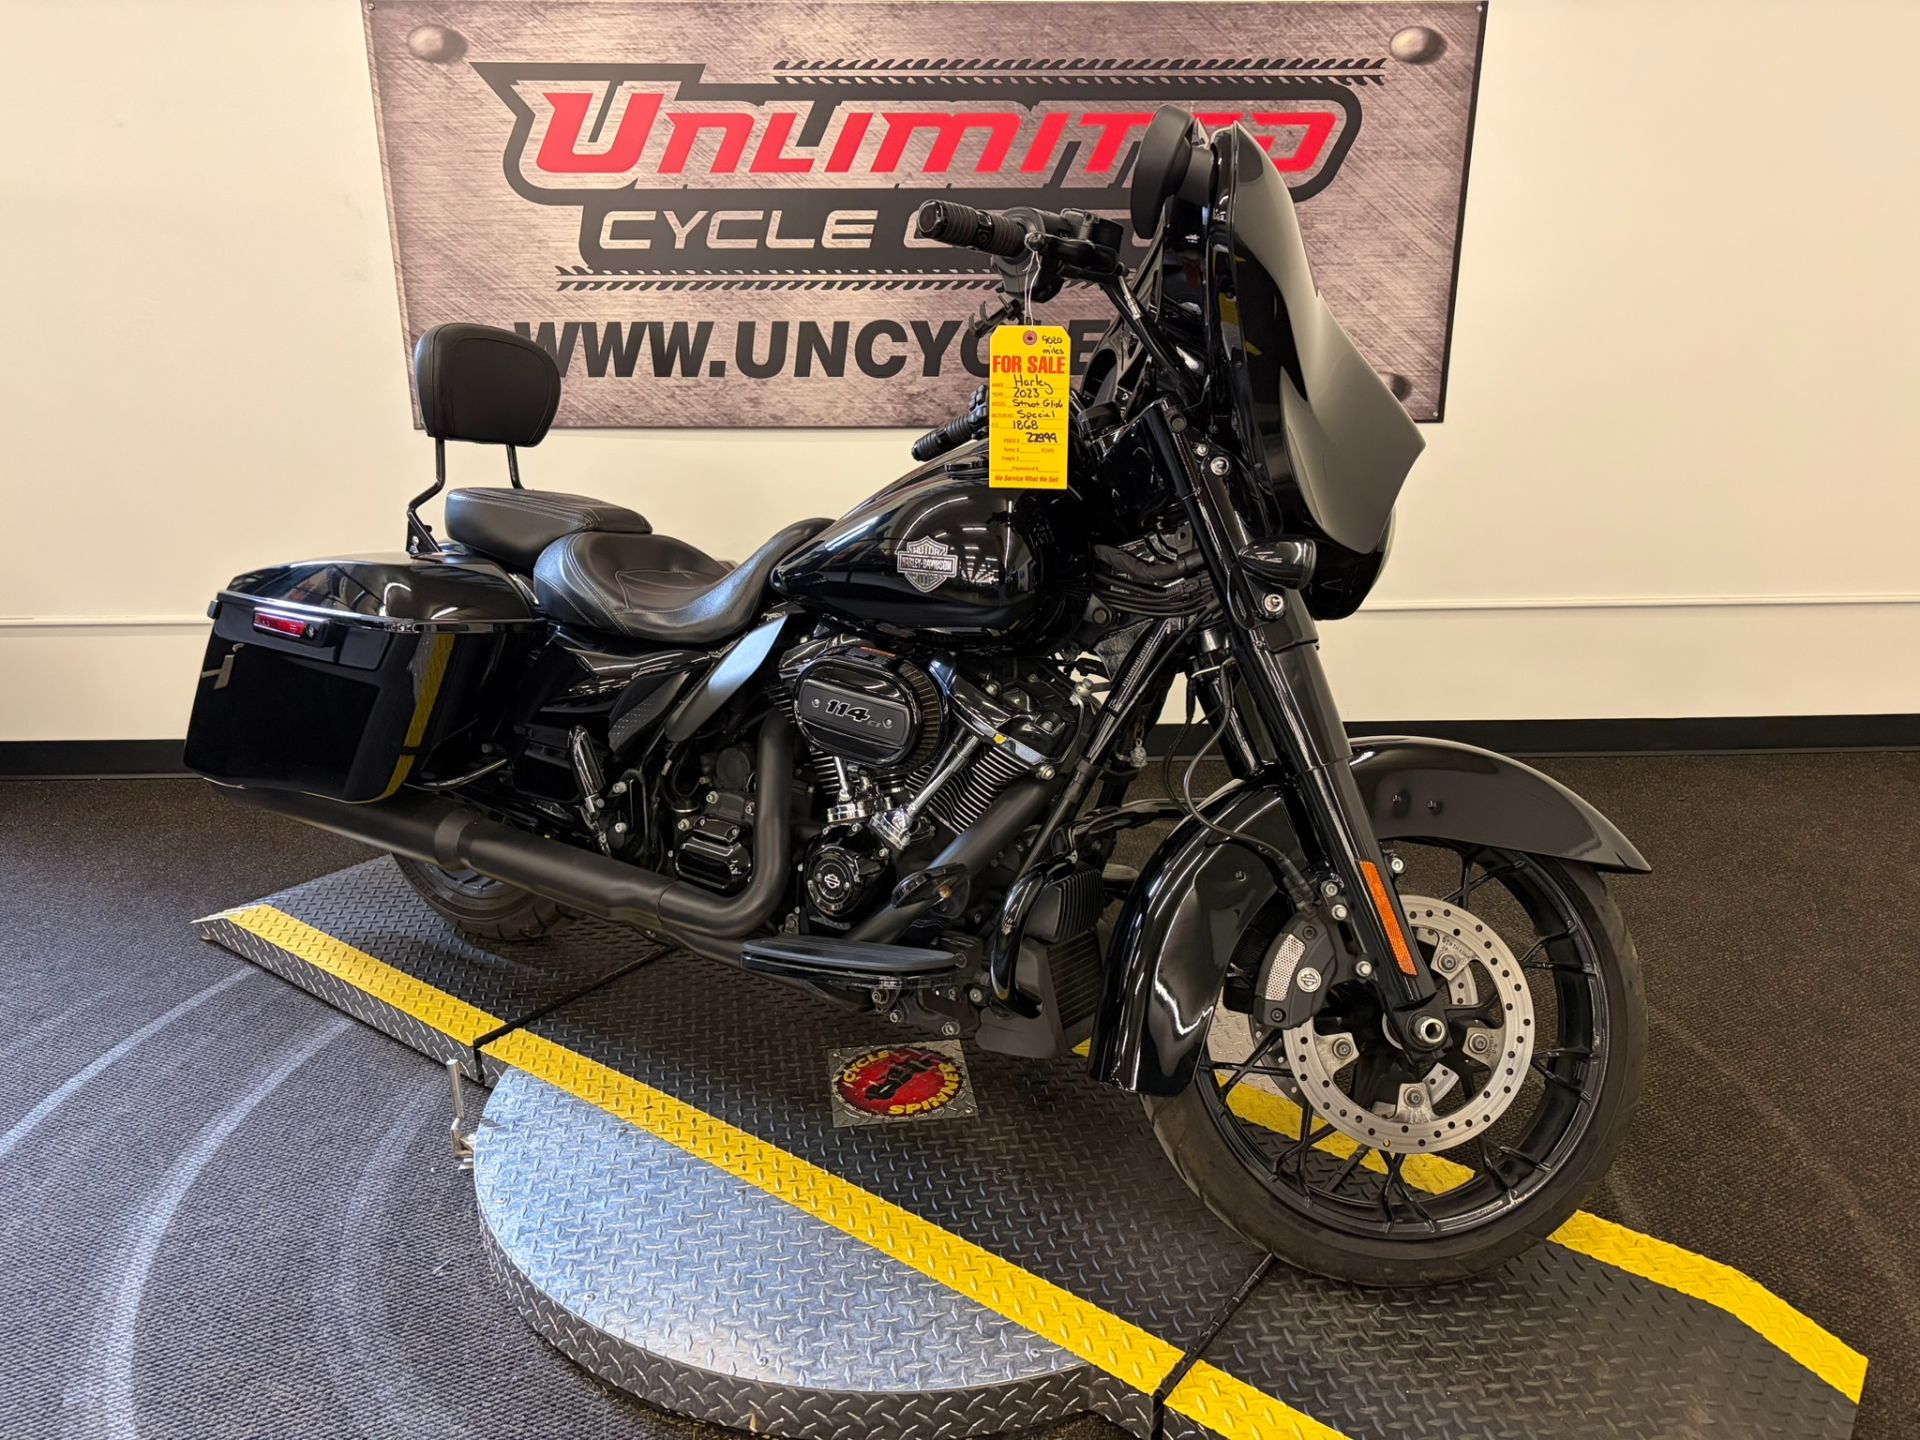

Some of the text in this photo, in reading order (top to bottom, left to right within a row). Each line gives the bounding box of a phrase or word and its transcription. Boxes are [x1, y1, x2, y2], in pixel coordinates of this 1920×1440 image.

[599, 209, 879, 249] CYCLE
[1042, 345, 1065, 355] miles
[992, 354, 1066, 375] FOR SALE
[1013, 373, 1054, 395] Harley
[1013, 388, 1040, 398] 2023
[1016, 409, 1056, 420] Special
[825, 699, 871, 722] 114
[843, 1050, 890, 1083] CYCLE
[889, 1062, 960, 1115] SPINNER
